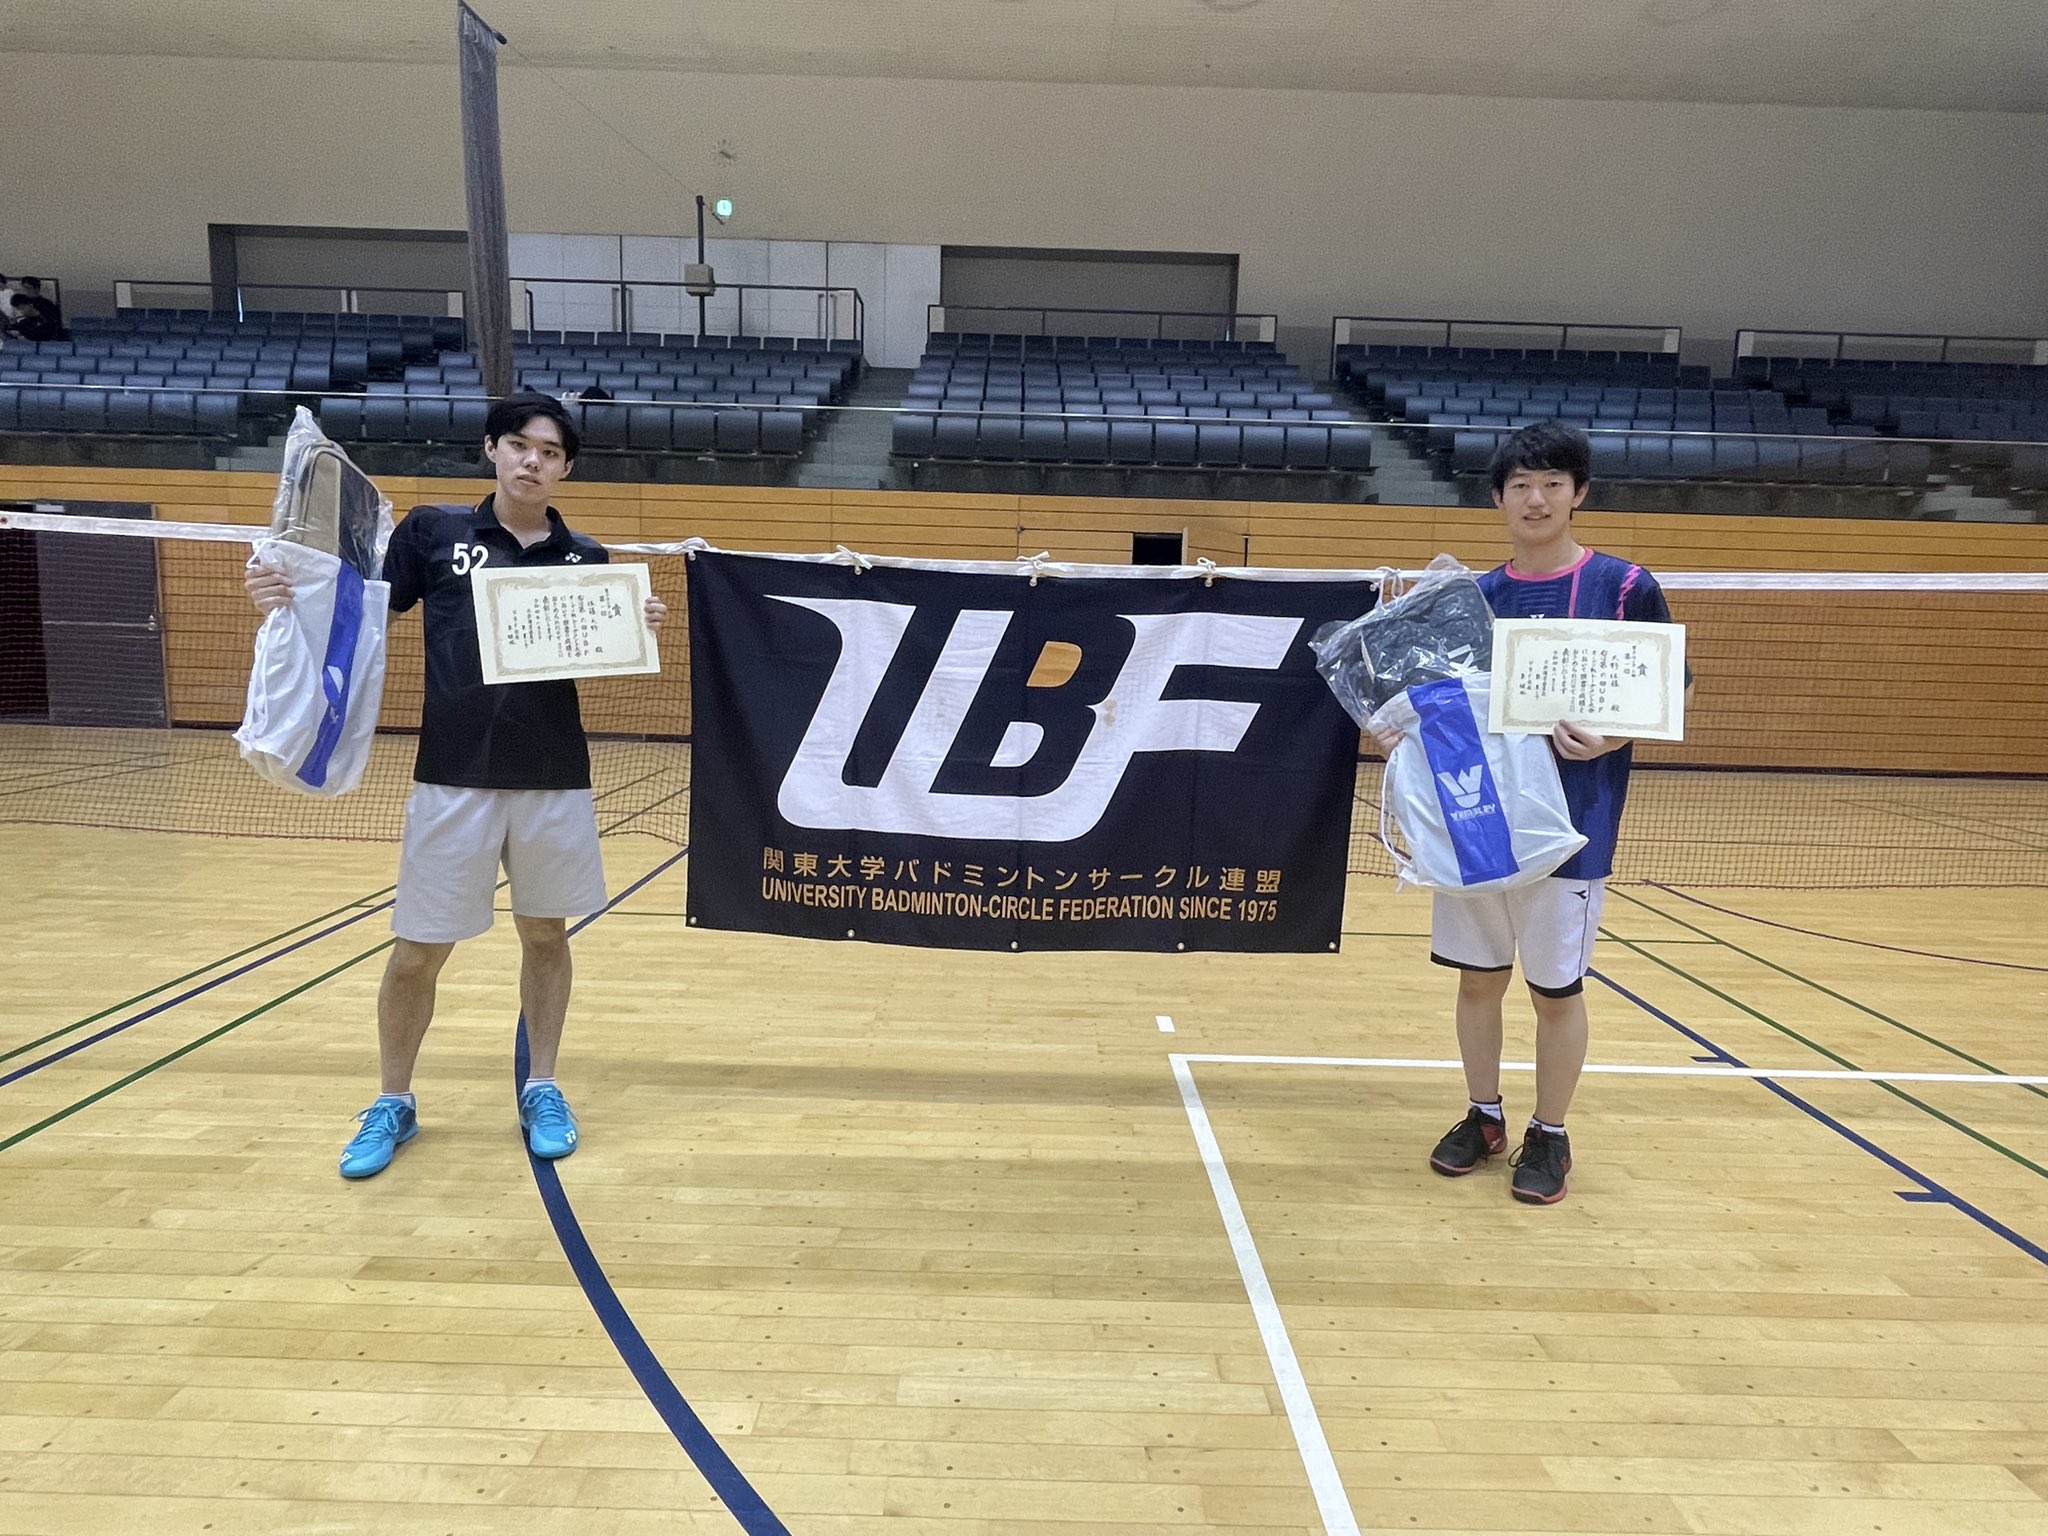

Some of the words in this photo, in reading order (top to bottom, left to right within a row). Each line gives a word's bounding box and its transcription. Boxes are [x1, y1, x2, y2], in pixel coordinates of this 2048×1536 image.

[452, 543, 488, 575] 52
[763, 594, 1304, 841] UBF
[763, 847, 1282, 893] 関東大学バドミントンサークル連盟
[761, 876, 867, 912] UNIVERSITY
[871, 888, 1053, 922] BADMINTON-CIRCLE
[1059, 896, 1175, 921] FEDERATION
[1179, 897, 1233, 920] SINCE
[1239, 900, 1278, 922] 1975
